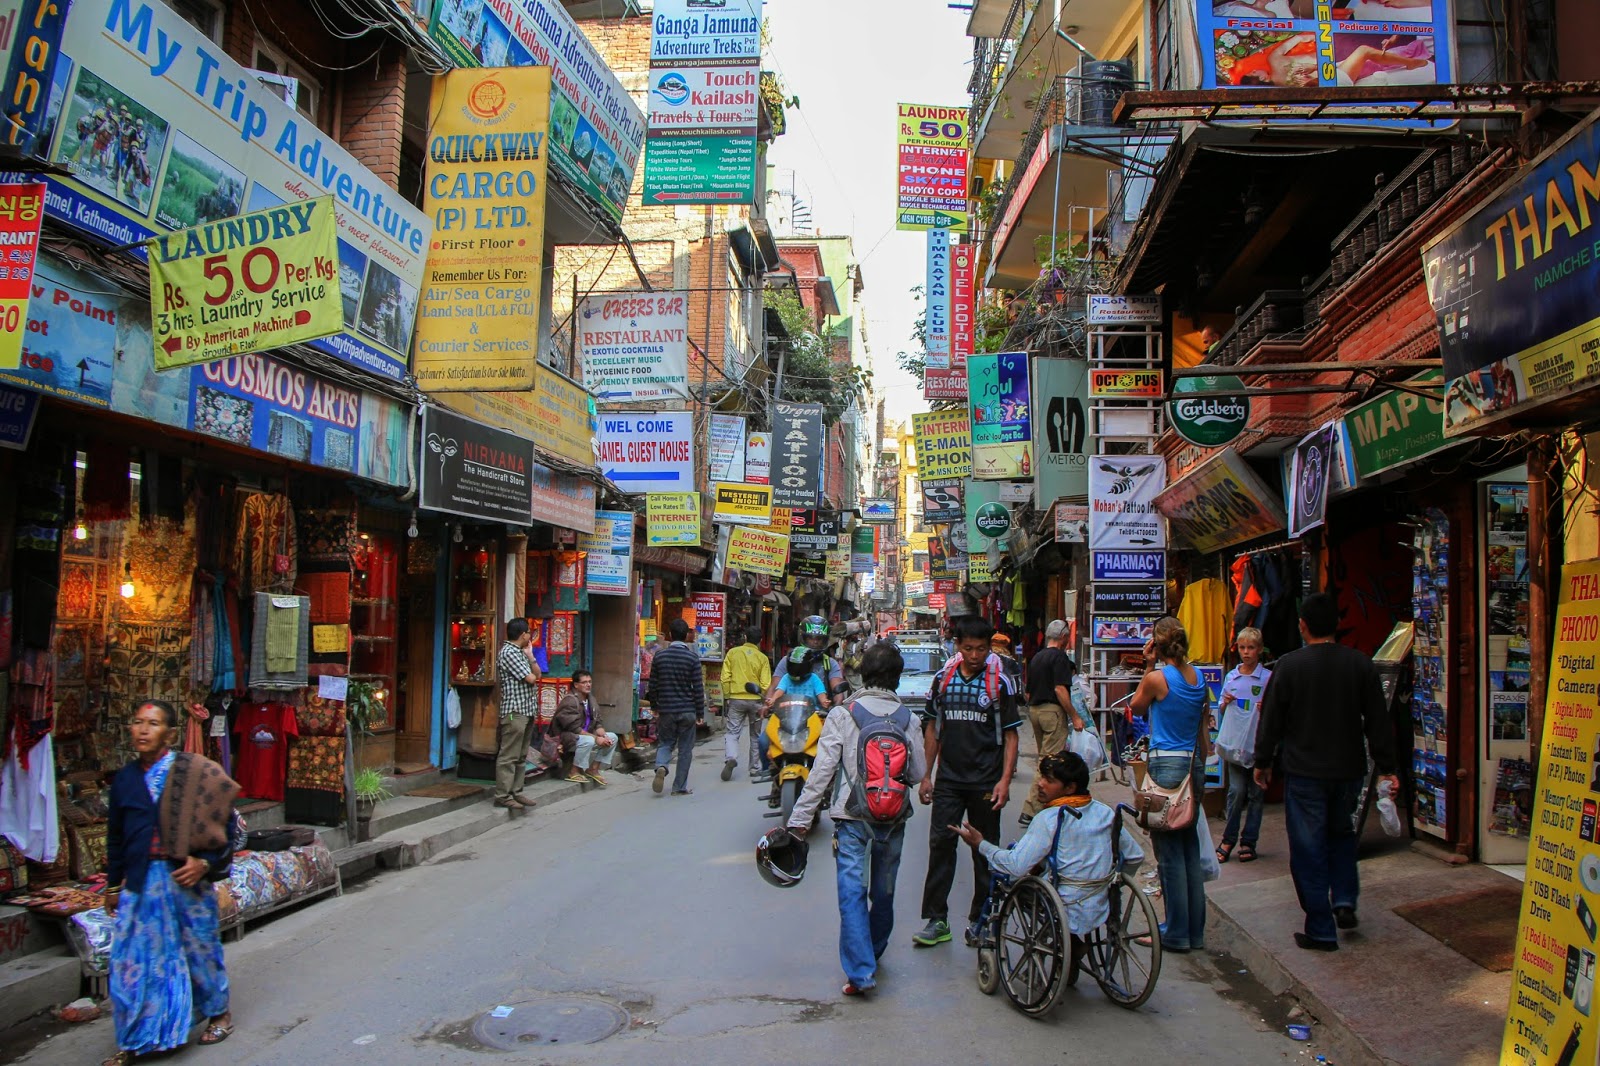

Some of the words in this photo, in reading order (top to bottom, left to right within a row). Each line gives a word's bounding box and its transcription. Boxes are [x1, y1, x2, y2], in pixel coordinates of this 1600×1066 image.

[656, 14, 698, 39] Ganga
[702, 13, 757, 34] Jamuna
[1227, 19, 1293, 29] Facial
[1339, 22, 1379, 32] Pedicure
[1392, 23, 1434, 34] Menicure
[654, 39, 710, 55] Adventure
[713, 38, 742, 54] Treks
[744, 37, 756, 45] Pvt.
[744, 46, 756, 54] Ltd.
[560, 31, 604, 98] Adventure
[514, 14, 550, 66] Kailash
[552, 56, 580, 104] Travels
[589, 102, 611, 139] Tours
[704, 70, 755, 87] Touch
[691, 89, 755, 105] Kailash
[651, 110, 692, 124] Travels
[696, 110, 705, 123] &
[709, 109, 742, 123] Tours
[898, 105, 967, 121] LAUNDRY
[105, 0, 183, 77] My
[194, 47, 267, 142] Trip
[275, 123, 423, 254] Adventure
[661, 128, 741, 136] www.touchkailash.com
[901, 123, 914, 136] Rs.
[919, 121, 963, 140] 50
[430, 132, 544, 164] QUICKWAY
[900, 145, 965, 157] INTERNET
[923, 139, 962, 147] KILOGRAM
[62, 155, 91, 179] Rafting
[905, 155, 962, 166] E-MAIL
[900, 165, 966, 176] PHONE
[430, 170, 536, 199] CARGO
[904, 175, 962, 186] SKYPE
[900, 186, 934, 195] PHOTO
[937, 188, 965, 197] COPY
[435, 207, 466, 232] (P)
[474, 205, 531, 230] LTD.
[916, 215, 935, 224] CYBER
[157, 201, 317, 264] LAUNDRY
[348, 223, 370, 244] meet
[441, 239, 475, 250] First
[479, 238, 514, 250] Floor
[931, 231, 946, 296] HIMALAYAN
[1534, 252, 1589, 291] NAMCHE
[163, 282, 190, 312] Rs.
[203, 246, 280, 306] 50
[284, 263, 312, 285] Per.
[313, 255, 336, 281] Kg.
[432, 269, 484, 282] Remember
[487, 269, 500, 281] Us
[485, 286, 531, 301] Cargo
[53, 288, 116, 325] Point
[157, 314, 171, 335] 3
[173, 311, 197, 331] hrs.
[200, 297, 263, 326] Laundry
[271, 282, 326, 309] Service
[422, 305, 452, 318] Land
[455, 305, 474, 318] Sea
[510, 303, 534, 317] FCL)
[602, 298, 654, 320] CHEERS
[657, 297, 683, 316] BAR
[932, 305, 945, 333] CLUB
[186, 335, 201, 351] By
[203, 325, 250, 347] American
[253, 315, 294, 334] Machine
[469, 321, 479, 335] &
[583, 329, 684, 346] RESTAURANT
[419, 339, 470, 353] Courier
[592, 348, 619, 356] EXOTIC
[621, 346, 664, 354] COCKTAILS
[592, 357, 636, 366] EXCELLENT
[639, 356, 662, 364] MUSIC
[1590, 350, 1598, 361] TO
[592, 367, 629, 376] HYGEINIC
[631, 366, 652, 374] FOOD
[1558, 360, 1575, 375] PHOTO
[632, 376, 685, 385] ENVIRONMENT
[982, 378, 1013, 397] Soul
[1096, 374, 1158, 387] OCTOPUS
[202, 354, 305, 411] COSMOS
[306, 380, 359, 429] ARTS
[1176, 398, 1245, 422] Carlsberg
[605, 421, 632, 433] WEL
[636, 420, 673, 433] COME
[1405, 430, 1441, 452] Posters,
[464, 441, 525, 474] NIRVANA
[627, 441, 656, 463] GUEST
[659, 441, 689, 462] HOUSE
[781, 418, 809, 487] TATTOO
[1046, 454, 1086, 466] METRO
[464, 463, 475, 474] The
[477, 468, 508, 482] Handicraft
[509, 475, 525, 487] Store
[936, 467, 952, 476] MSN
[721, 491, 758, 500] WESTERN
[775, 488, 790, 497] Piercing
[796, 489, 814, 497] Dreadlock
[1093, 498, 1122, 514] Mohan's
[1122, 500, 1145, 514] Tattoo
[650, 514, 698, 522] INTERNET
[978, 516, 1008, 528] Carlsberg
[742, 531, 777, 544] MONEY
[731, 539, 785, 555] EXCHANGE
[751, 557, 782, 568] CASH
[1096, 553, 1162, 571] PHARMACY
[1560, 614, 1598, 642] PHOTO
[1557, 678, 1595, 695] Camera
[1493, 694, 1526, 703] PRAXIS
[945, 709, 987, 723] SAMSUNG
[1554, 701, 1574, 720] Digital
[1574, 703, 1593, 719] Photo
[1550, 742, 1572, 761] Instant
[1530, 900, 1551, 922] Drive
[1551, 938, 1566, 960] Phone
[1521, 946, 1554, 975] Accessories
[1519, 970, 1541, 993] Camera
